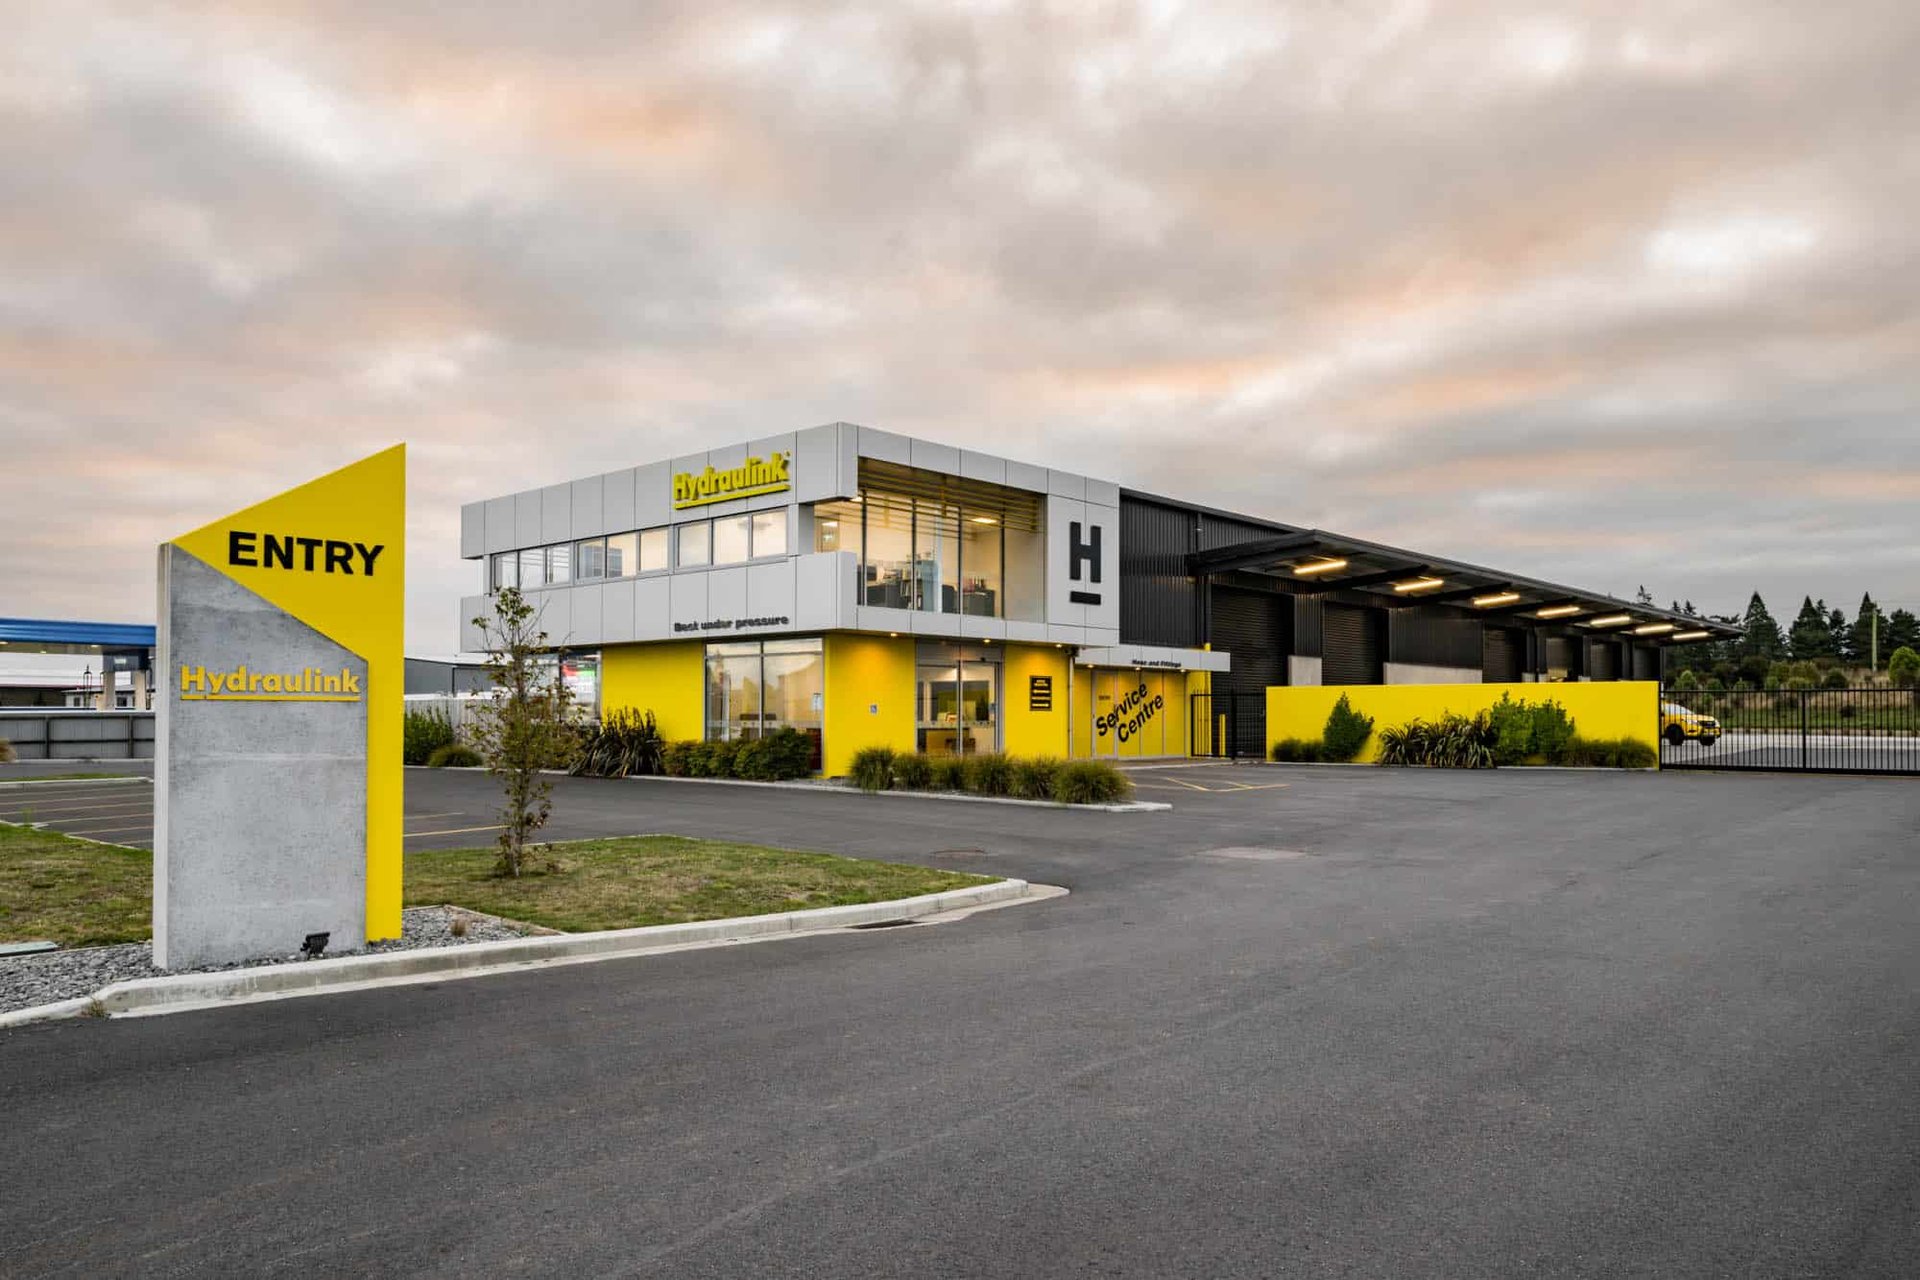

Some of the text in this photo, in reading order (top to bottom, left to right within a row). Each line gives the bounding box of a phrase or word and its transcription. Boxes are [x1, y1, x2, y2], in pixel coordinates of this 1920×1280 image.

[674, 452, 789, 501] Hydraulink
[228, 531, 385, 577] ENTRY
[1069, 521, 1102, 584] H
[674, 616, 790, 632] Best under pressure
[180, 664, 360, 694] Hydraulink
[1096, 683, 1148, 737] Service
[1118, 695, 1164, 743] Centre
